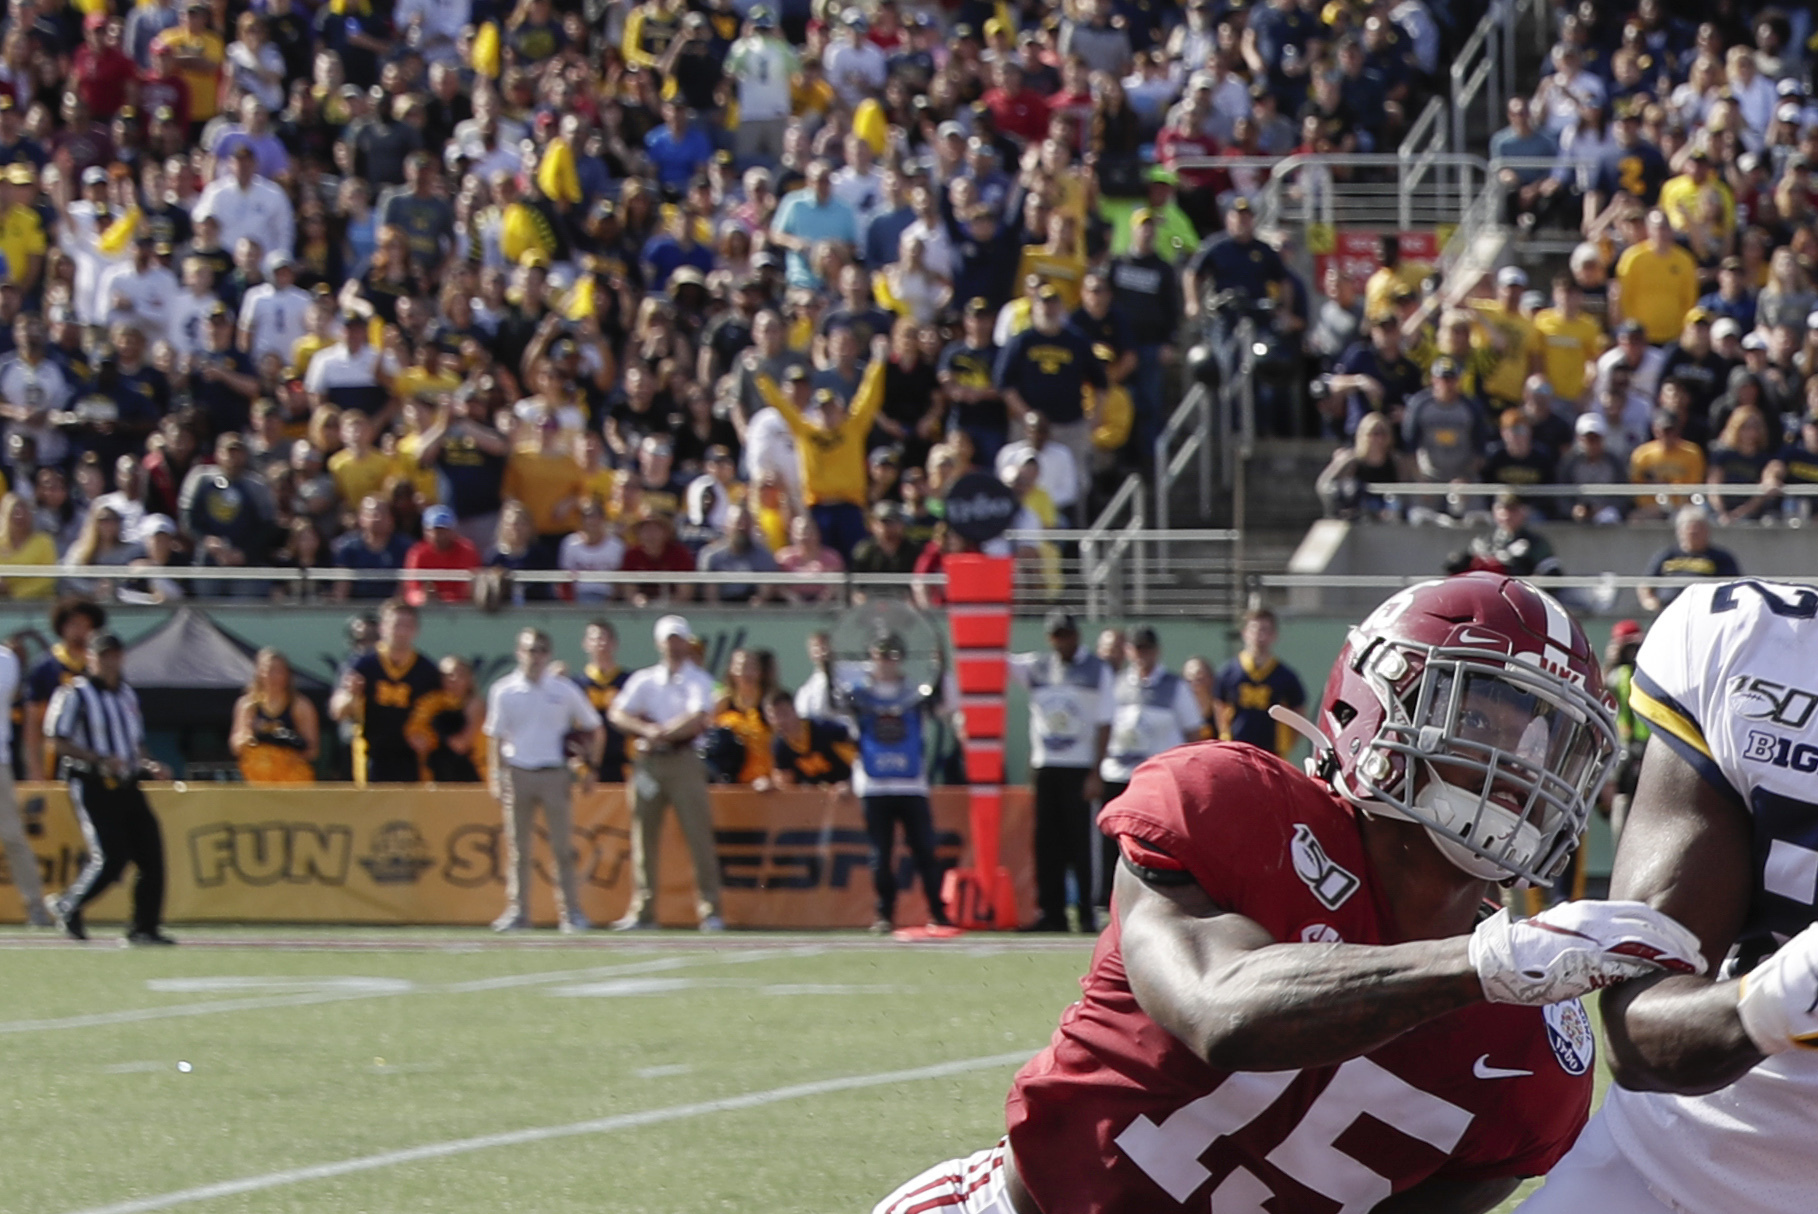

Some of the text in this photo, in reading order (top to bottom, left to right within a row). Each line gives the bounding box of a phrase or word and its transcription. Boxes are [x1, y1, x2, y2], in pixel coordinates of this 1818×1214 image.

[189, 821, 352, 887] FUN
[1294, 824, 1360, 910] 150
[1555, 1037, 1579, 1070] Vrbo
